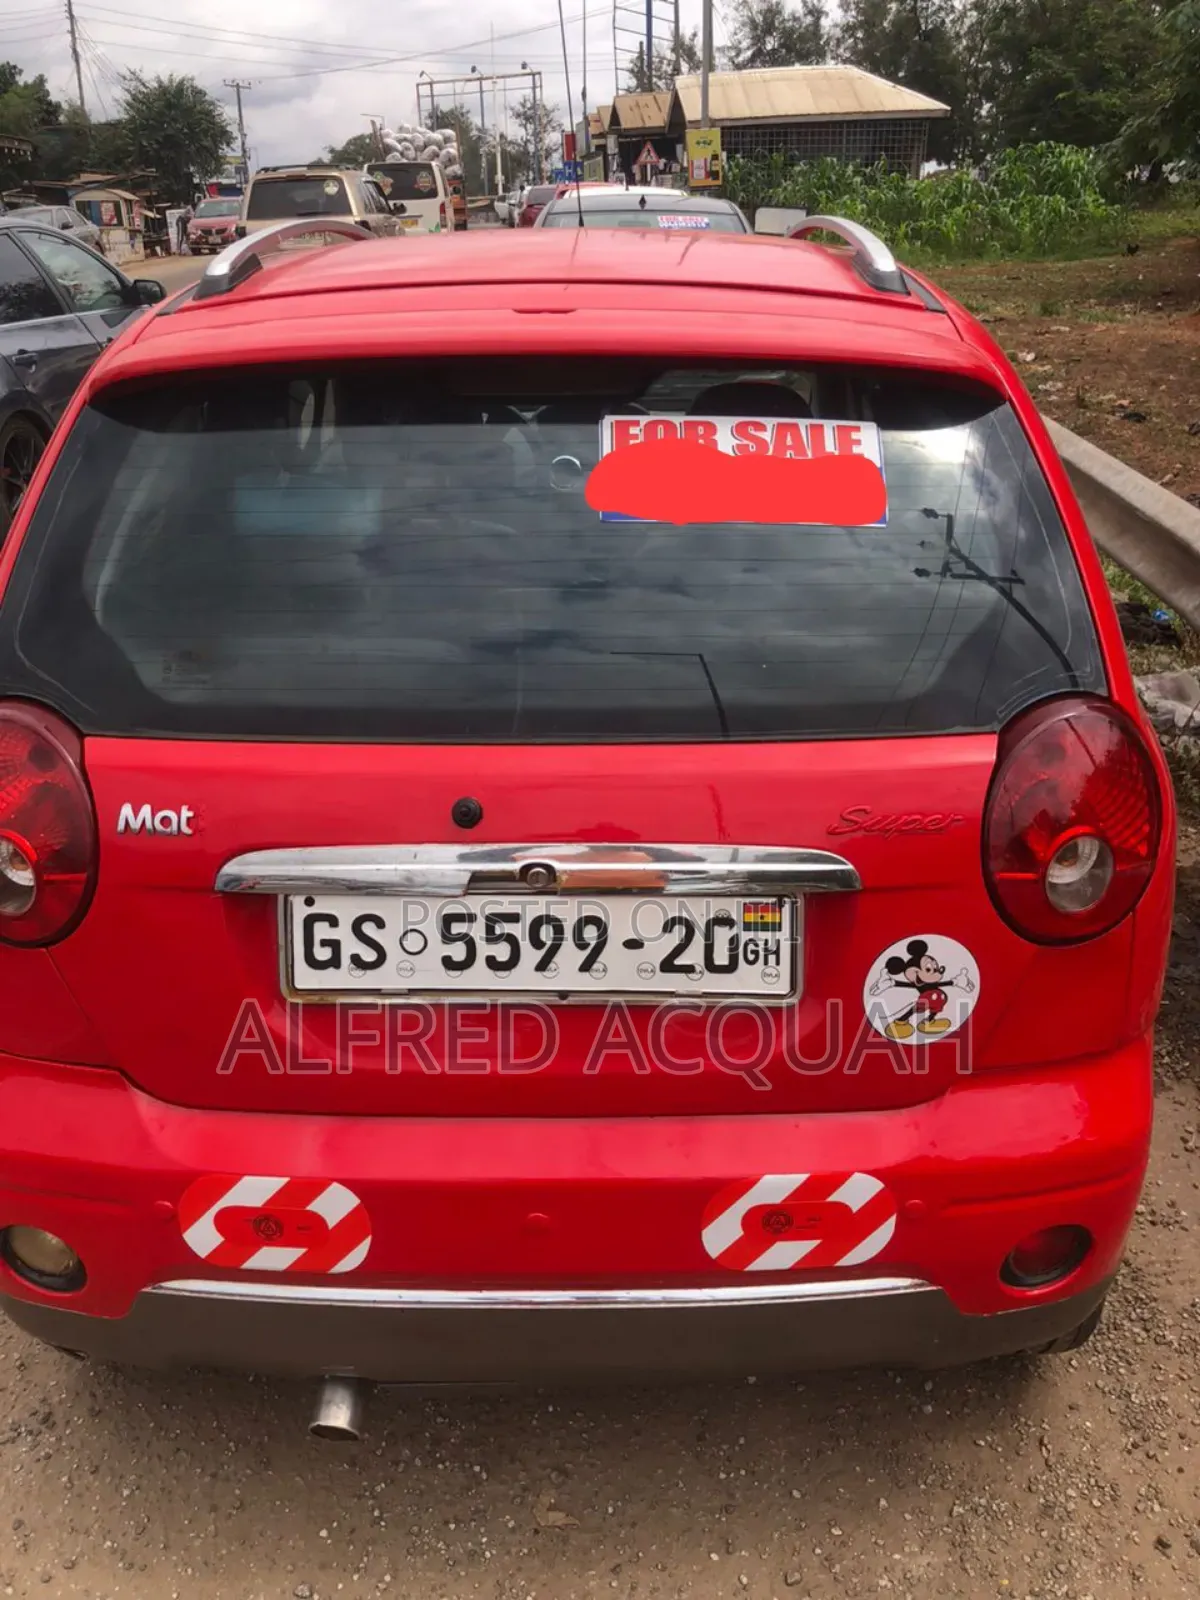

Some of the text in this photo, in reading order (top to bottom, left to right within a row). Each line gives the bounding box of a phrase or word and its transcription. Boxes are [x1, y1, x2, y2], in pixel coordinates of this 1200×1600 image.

[731, 420, 864, 459] SALE
[117, 802, 194, 835] Mat
[826, 804, 964, 841] Super
[303, 912, 387, 971] GS
[742, 937, 781, 967] GH
